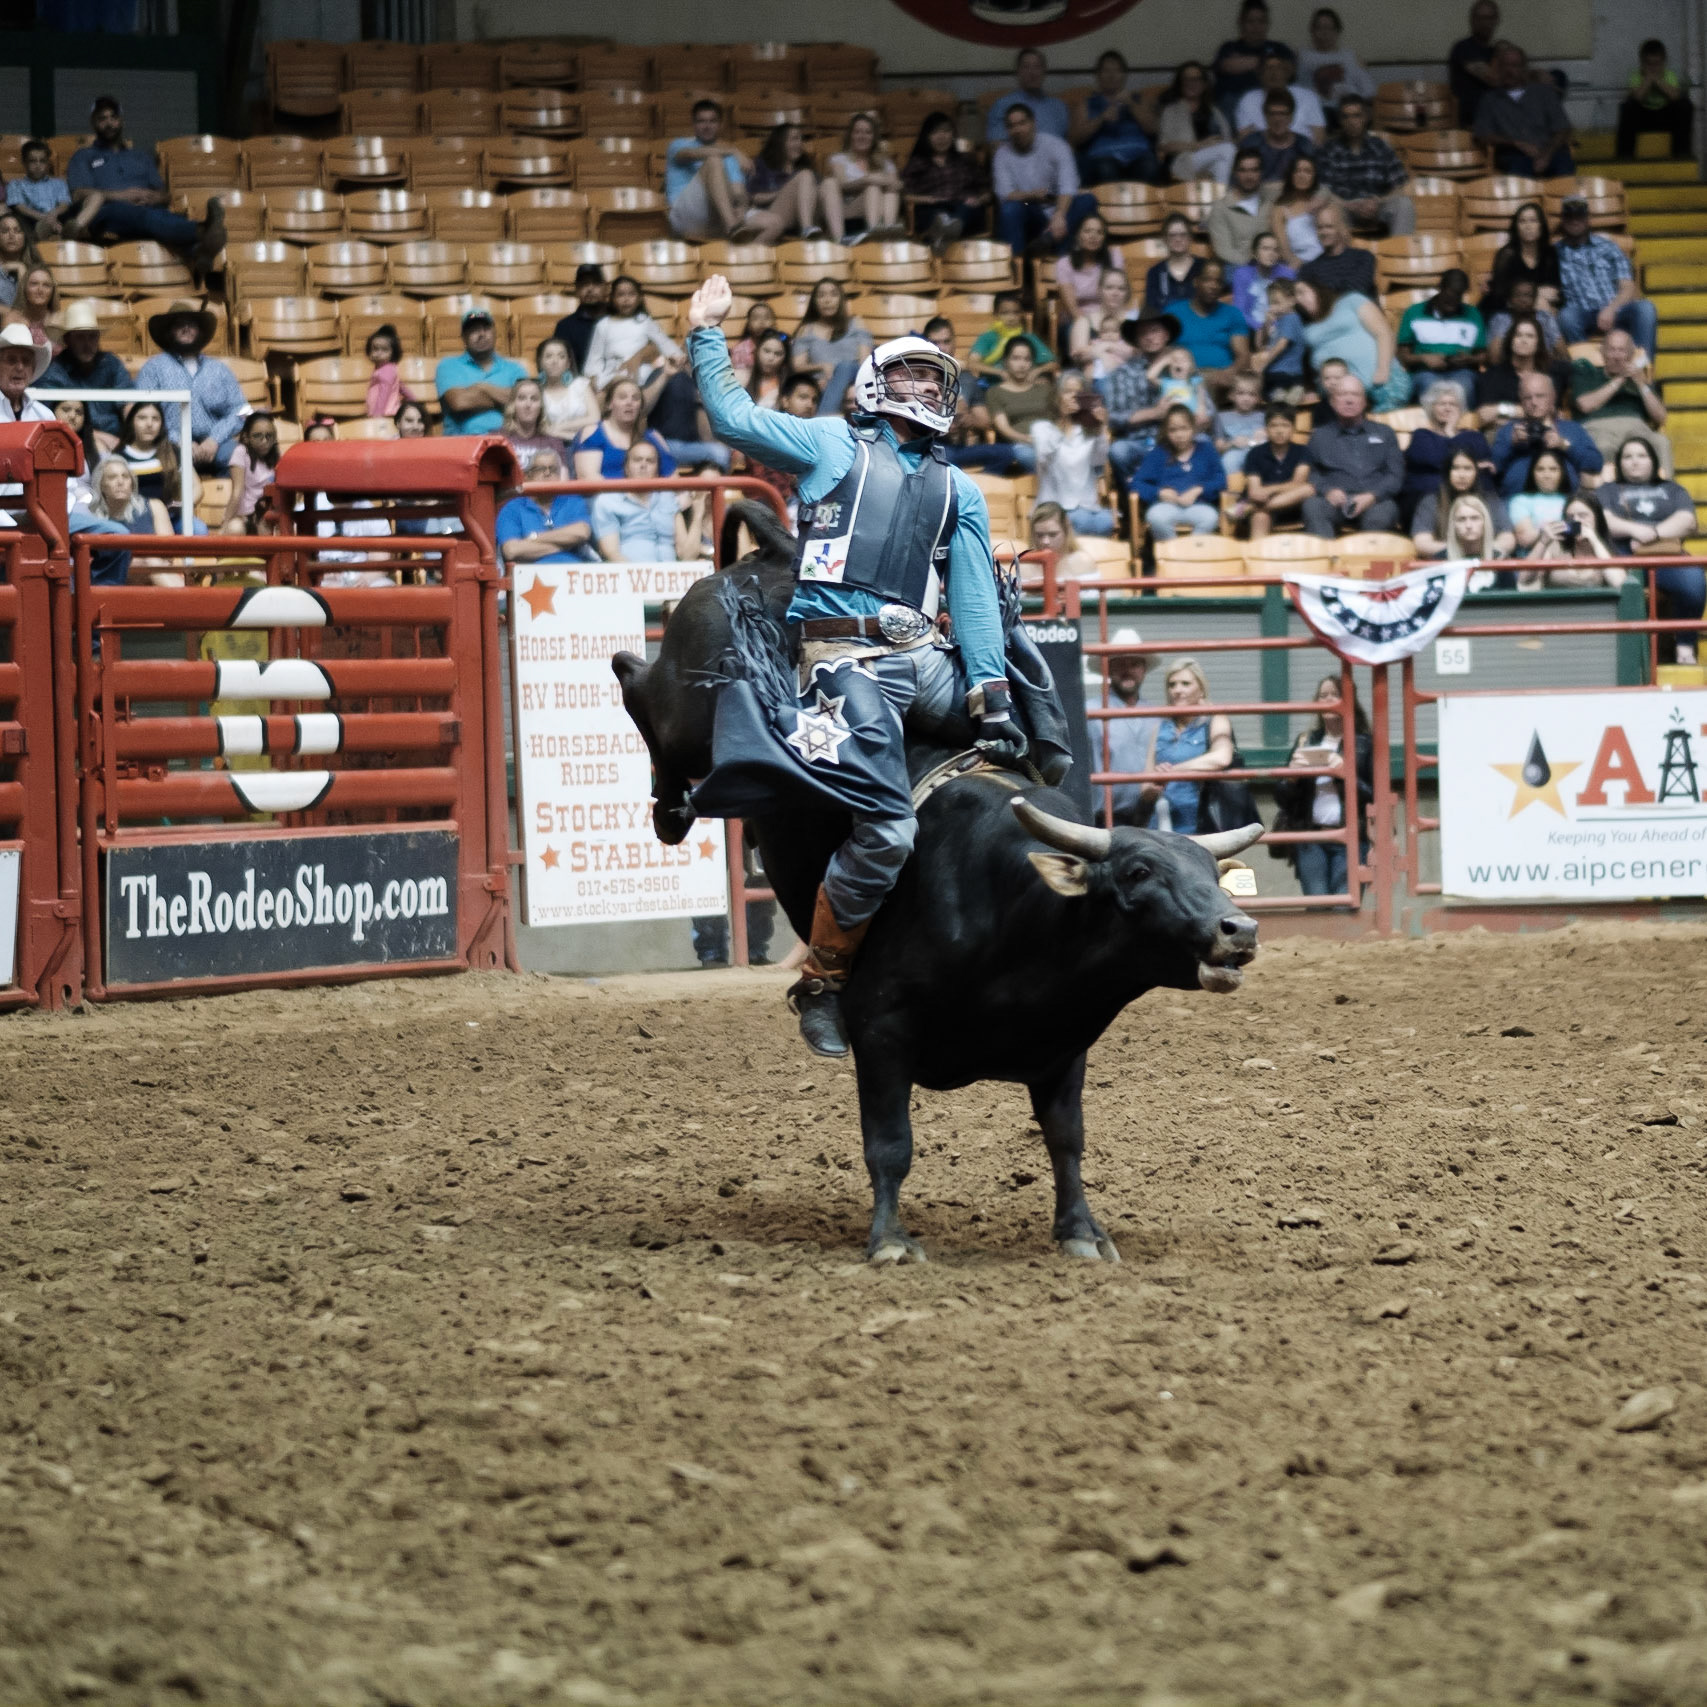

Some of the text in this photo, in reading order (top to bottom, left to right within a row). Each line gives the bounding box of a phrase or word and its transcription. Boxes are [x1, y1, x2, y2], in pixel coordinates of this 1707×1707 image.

[567, 570, 620, 595] FORT
[1025, 625, 1077, 643] Rodeo
[520, 634, 566, 661] HORSE
[1442, 648, 1464, 665] 55
[522, 682, 624, 710] RV HOOK-U
[530, 733, 650, 758] HORSEBACK
[561, 762, 619, 786] RIDES
[1547, 827, 1707, 847] Keeping You Ahead of
[571, 841, 691, 872] STABLES
[1468, 856, 1707, 887] www.aipcener
[121, 864, 448, 941] TheRodeoShop.com
